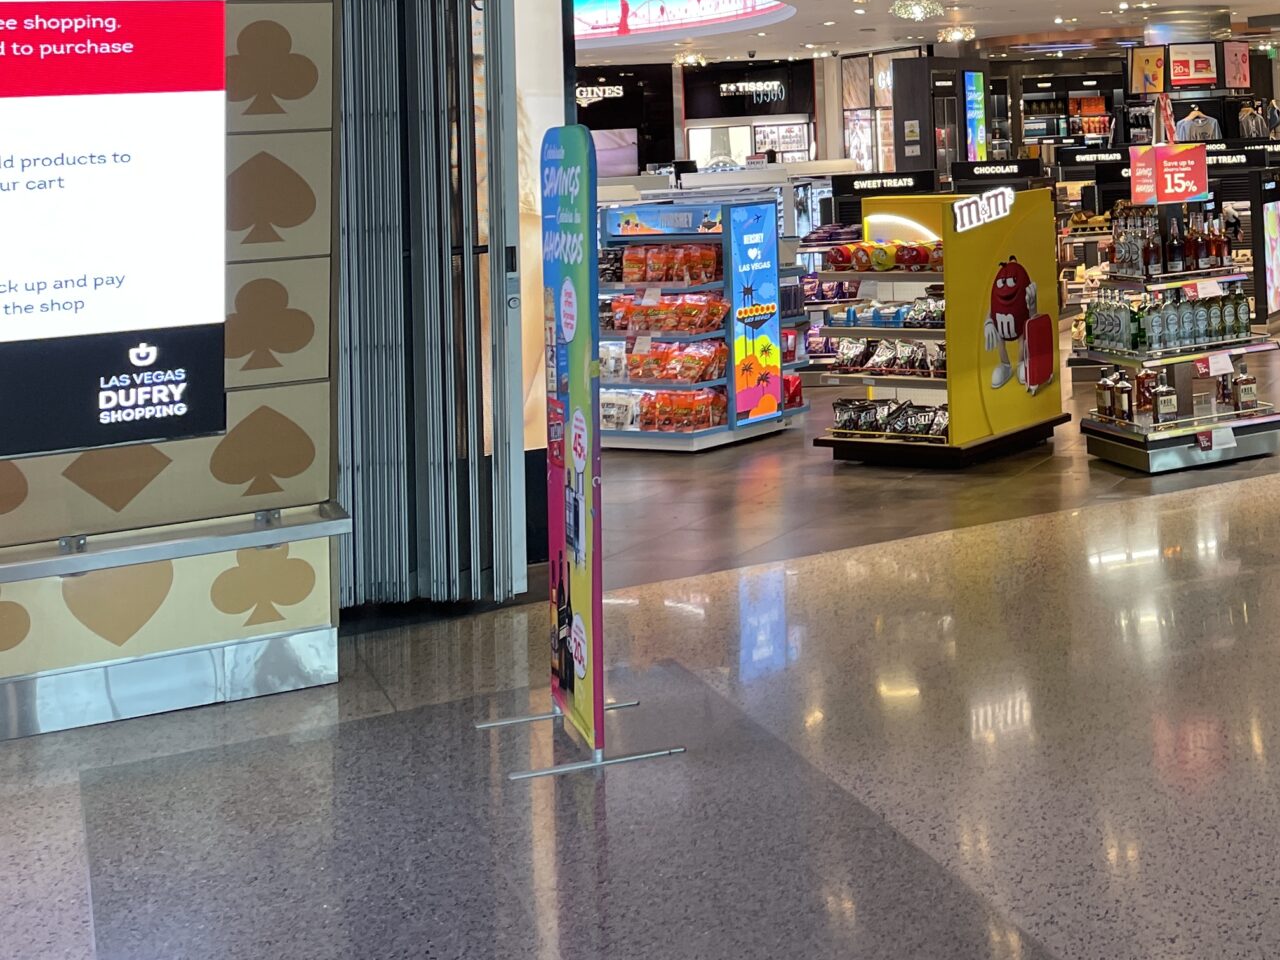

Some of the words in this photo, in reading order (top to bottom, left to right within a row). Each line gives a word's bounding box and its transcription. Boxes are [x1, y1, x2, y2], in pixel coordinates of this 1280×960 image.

[23, 14, 122, 33] shopping.
[11, 41, 34, 56] to
[40, 39, 134, 59] purchase
[737, 81, 781, 91] TISSOT
[21, 152, 107, 172] products
[112, 151, 131, 164] to
[1075, 153, 1099, 162] SWEET
[1100, 152, 1121, 161] TREATS
[1218, 155, 1247, 164] TREATS
[974, 165, 1019, 175] CHOCOLATE
[25, 176, 65, 191] cart
[543, 165, 581, 204] SAVINGS
[853, 180, 882, 189] SWEET
[883, 178, 914, 187] TREATS
[1164, 173, 1198, 194] 15%
[543, 231, 584, 265] AHORROS
[738, 264, 751, 273] LAS
[751, 261, 771, 270] VEGAS
[24, 280, 48, 295] up
[53, 274, 88, 290] and
[93, 273, 126, 290] pay
[3, 302, 34, 315] the
[39, 299, 85, 314] shop
[99, 373, 131, 388] LAS
[132, 368, 187, 385] VEGAS
[98, 383, 187, 410] DUFRY
[99, 402, 188, 424] SHOPPING
